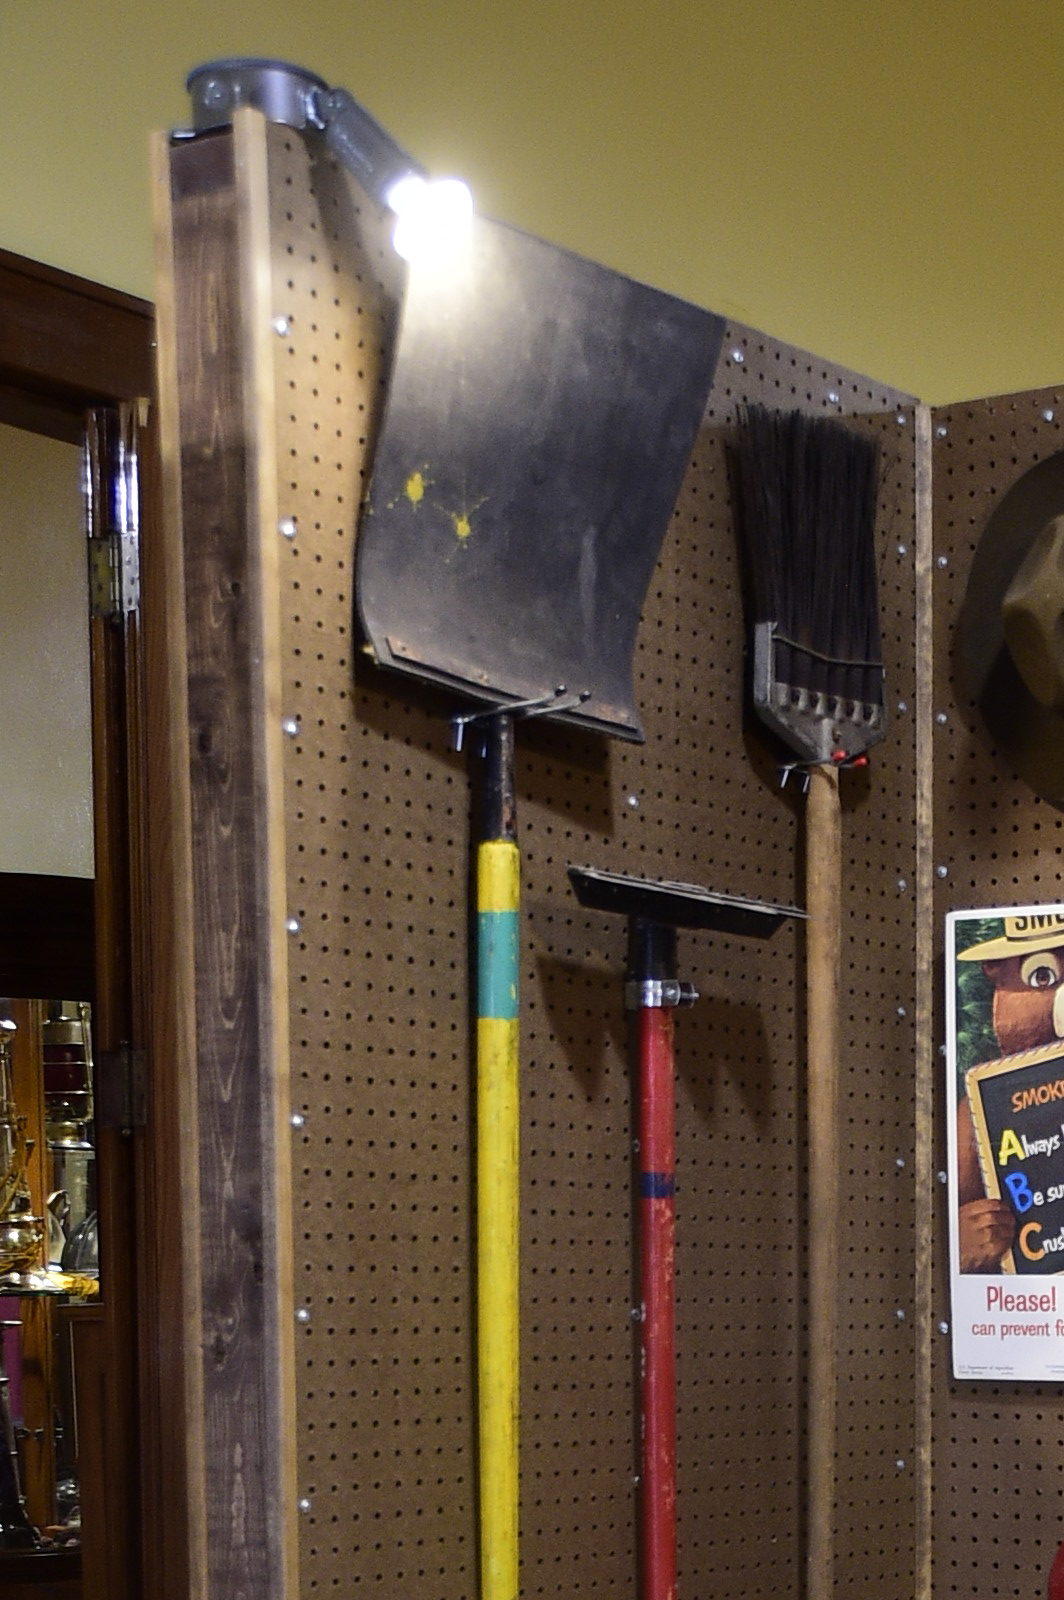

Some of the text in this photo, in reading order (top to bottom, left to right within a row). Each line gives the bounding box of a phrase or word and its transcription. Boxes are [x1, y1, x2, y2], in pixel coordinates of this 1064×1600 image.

[999, 1128, 1060, 1166] Always
[1004, 1171, 1045, 1213] Be
[987, 1286, 1056, 1313] Please!
[971, 1321, 996, 1336] can
[1000, 1320, 1051, 1341] prevent
